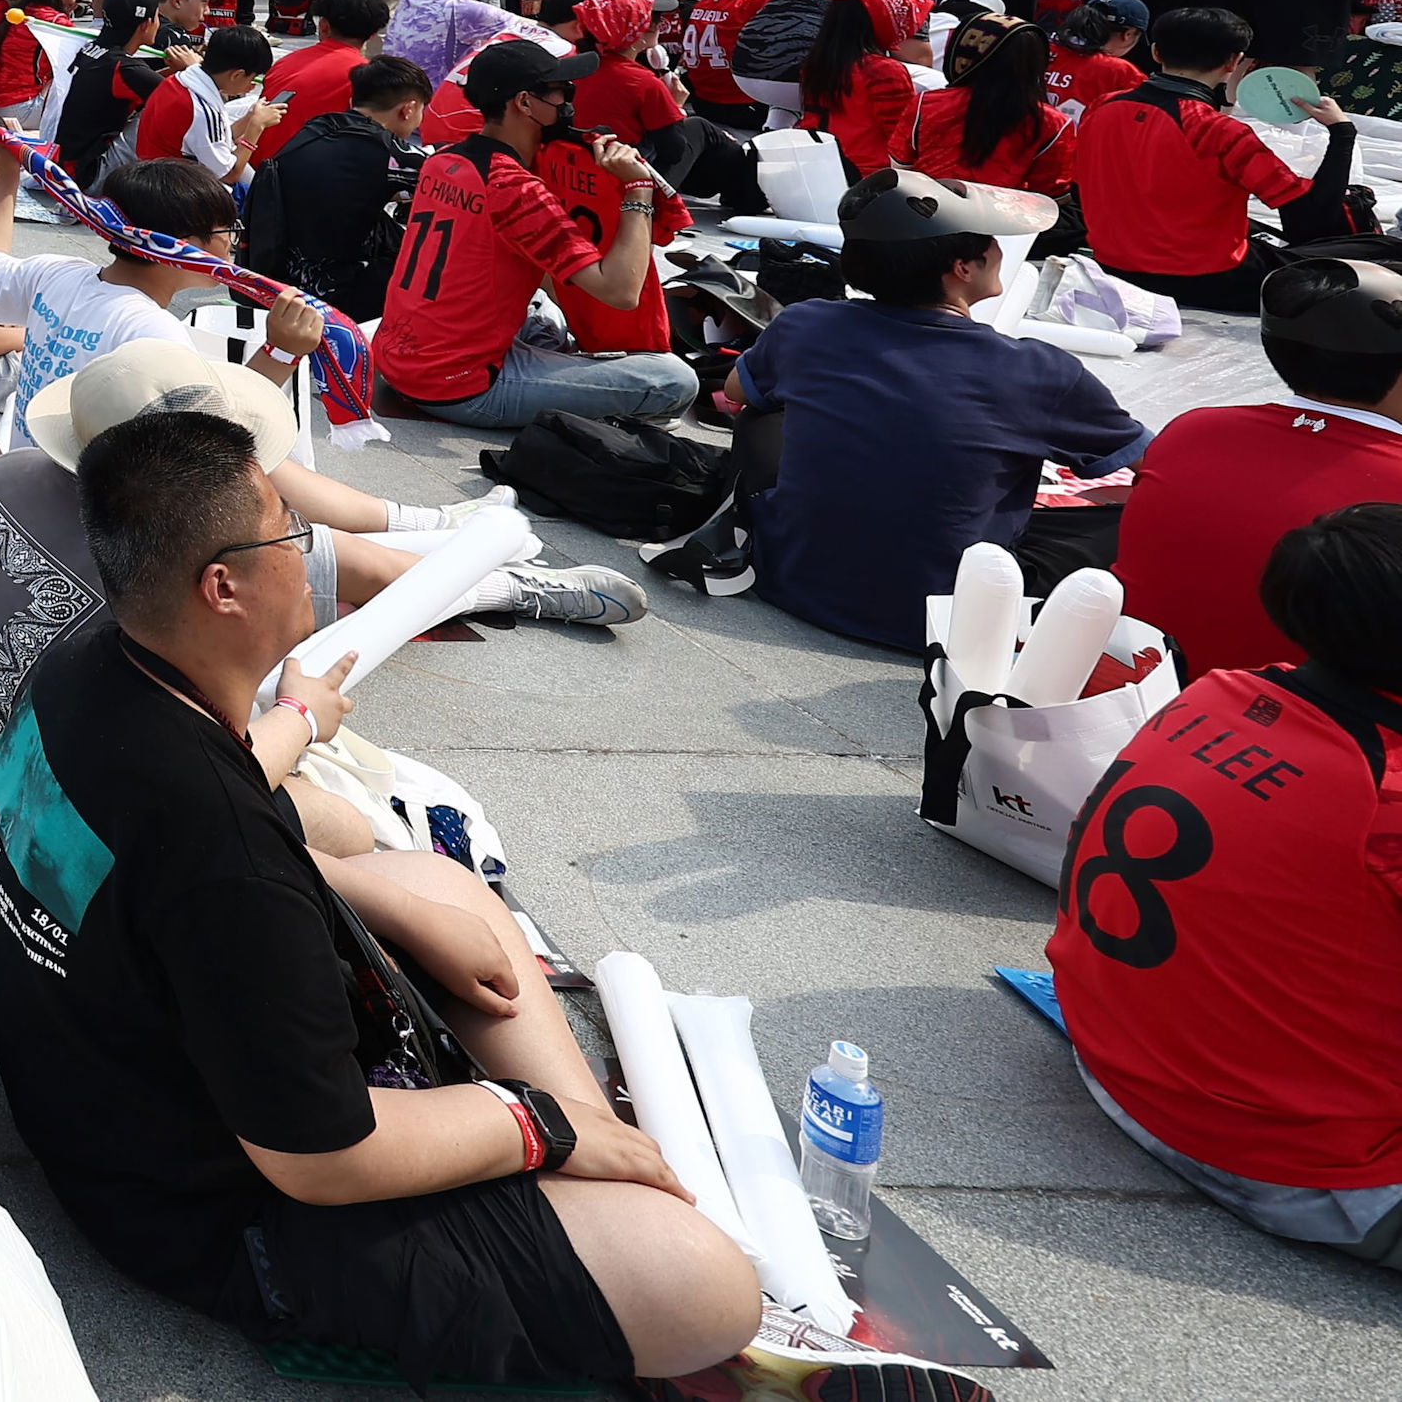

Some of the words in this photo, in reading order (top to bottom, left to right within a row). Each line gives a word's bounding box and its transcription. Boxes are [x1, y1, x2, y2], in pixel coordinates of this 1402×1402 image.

[682, 24, 730, 69] 94
[429, 181, 484, 215] HWANG
[569, 170, 598, 197] LEE
[399, 211, 455, 302] 11
[1190, 731, 1304, 802] LEE
[992, 785, 1035, 818] kt
[30, 907, 69, 946] 18/01
[44, 958, 68, 979] RAIN
[982, 1326, 1021, 1352] kt
